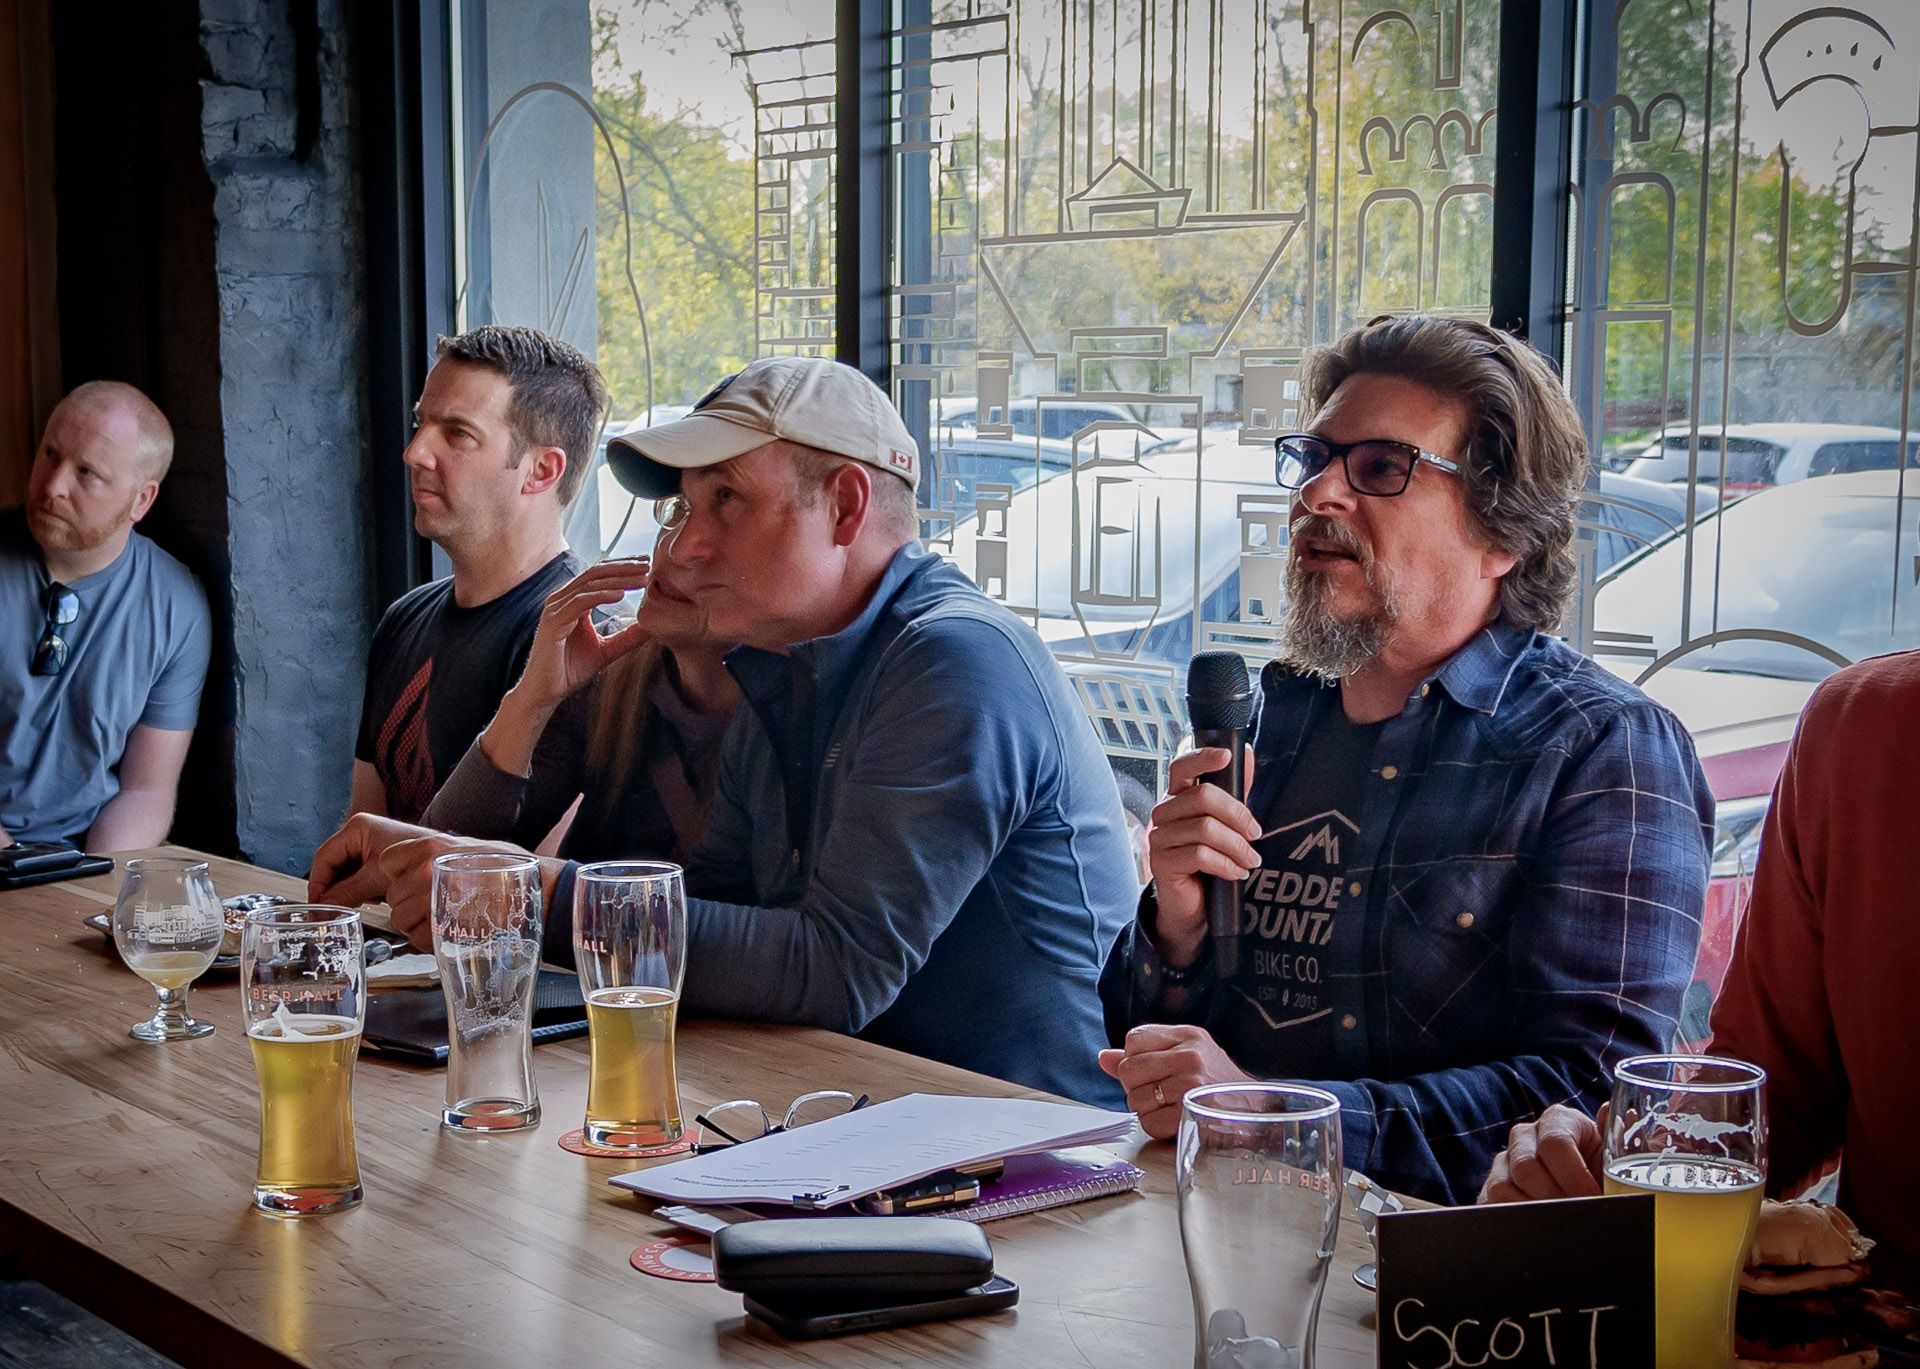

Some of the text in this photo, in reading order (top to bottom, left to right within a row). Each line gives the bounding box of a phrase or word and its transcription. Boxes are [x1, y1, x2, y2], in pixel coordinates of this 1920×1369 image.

[1254, 950, 1323, 984] BIKE CO.
[252, 987, 344, 1003] BEER HALL
[1393, 1297, 1620, 1369] SCOTT
